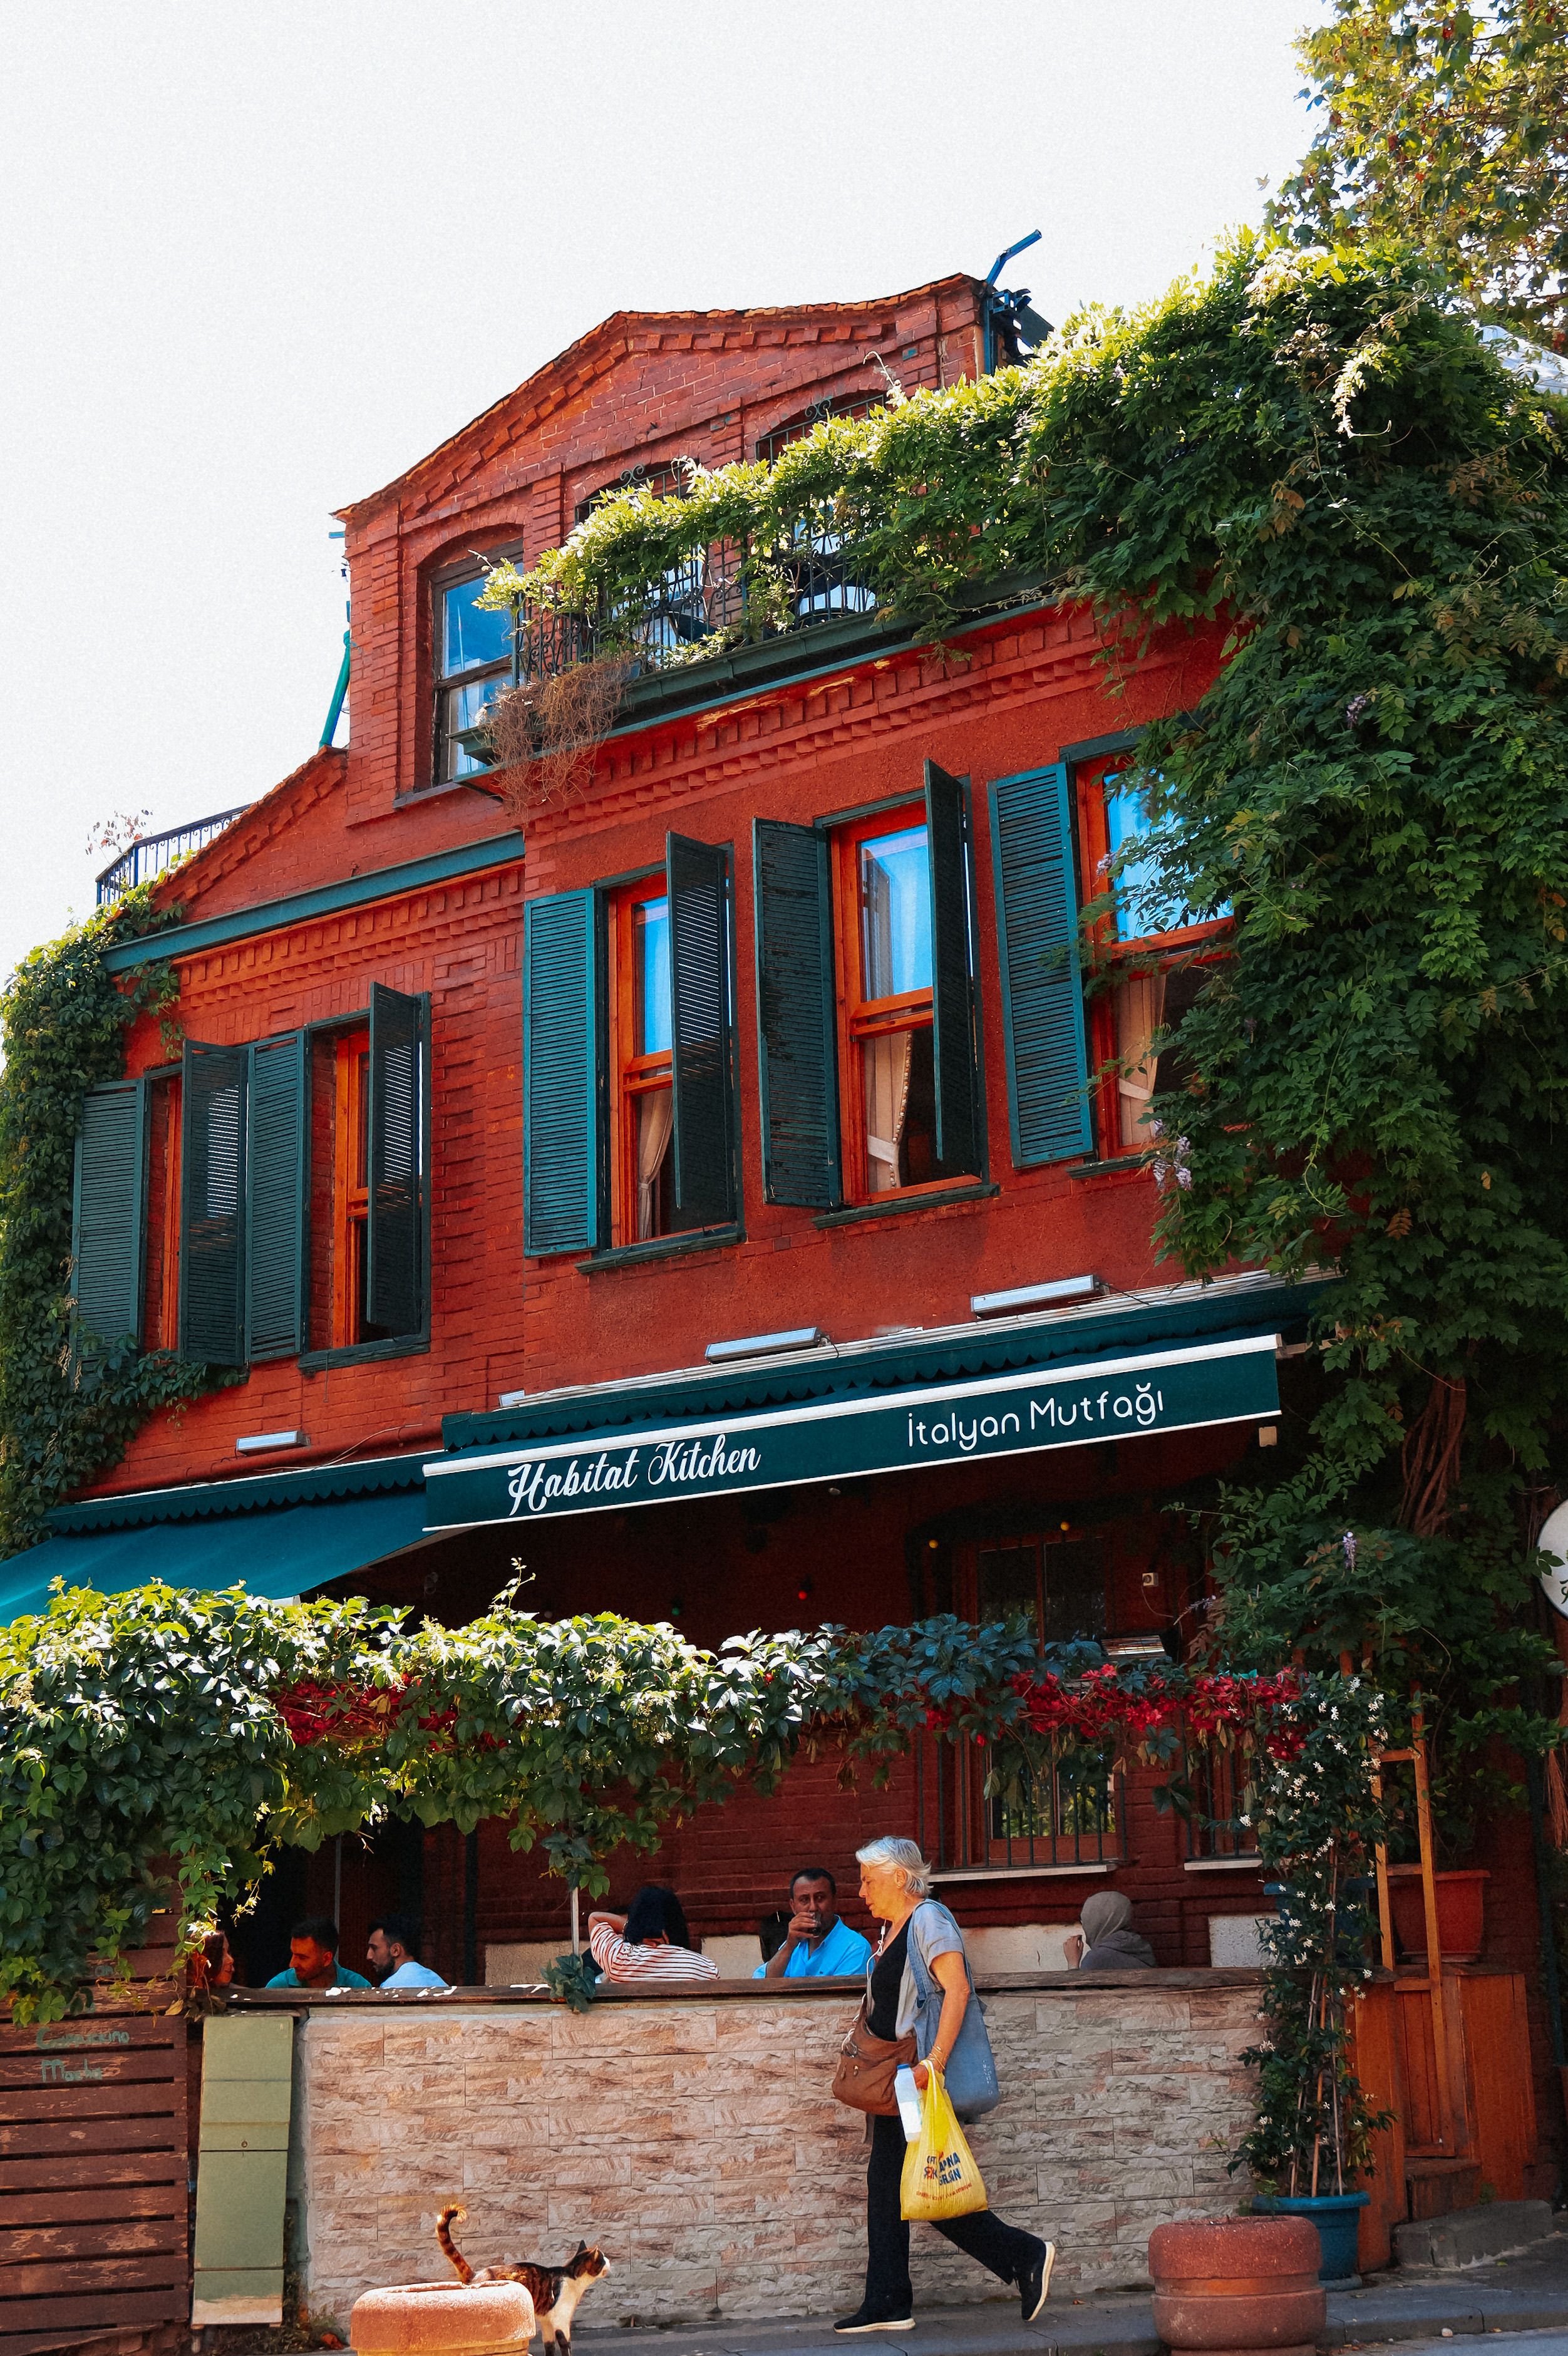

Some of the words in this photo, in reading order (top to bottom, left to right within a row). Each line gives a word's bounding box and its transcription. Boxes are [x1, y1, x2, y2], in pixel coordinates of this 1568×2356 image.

[908, 1413, 1020, 1450] İtalyan
[1030, 1382, 1163, 1425] Mutfağı
[507, 1448, 639, 1516] Habitat
[648, 1434, 761, 1485] Kitchen
